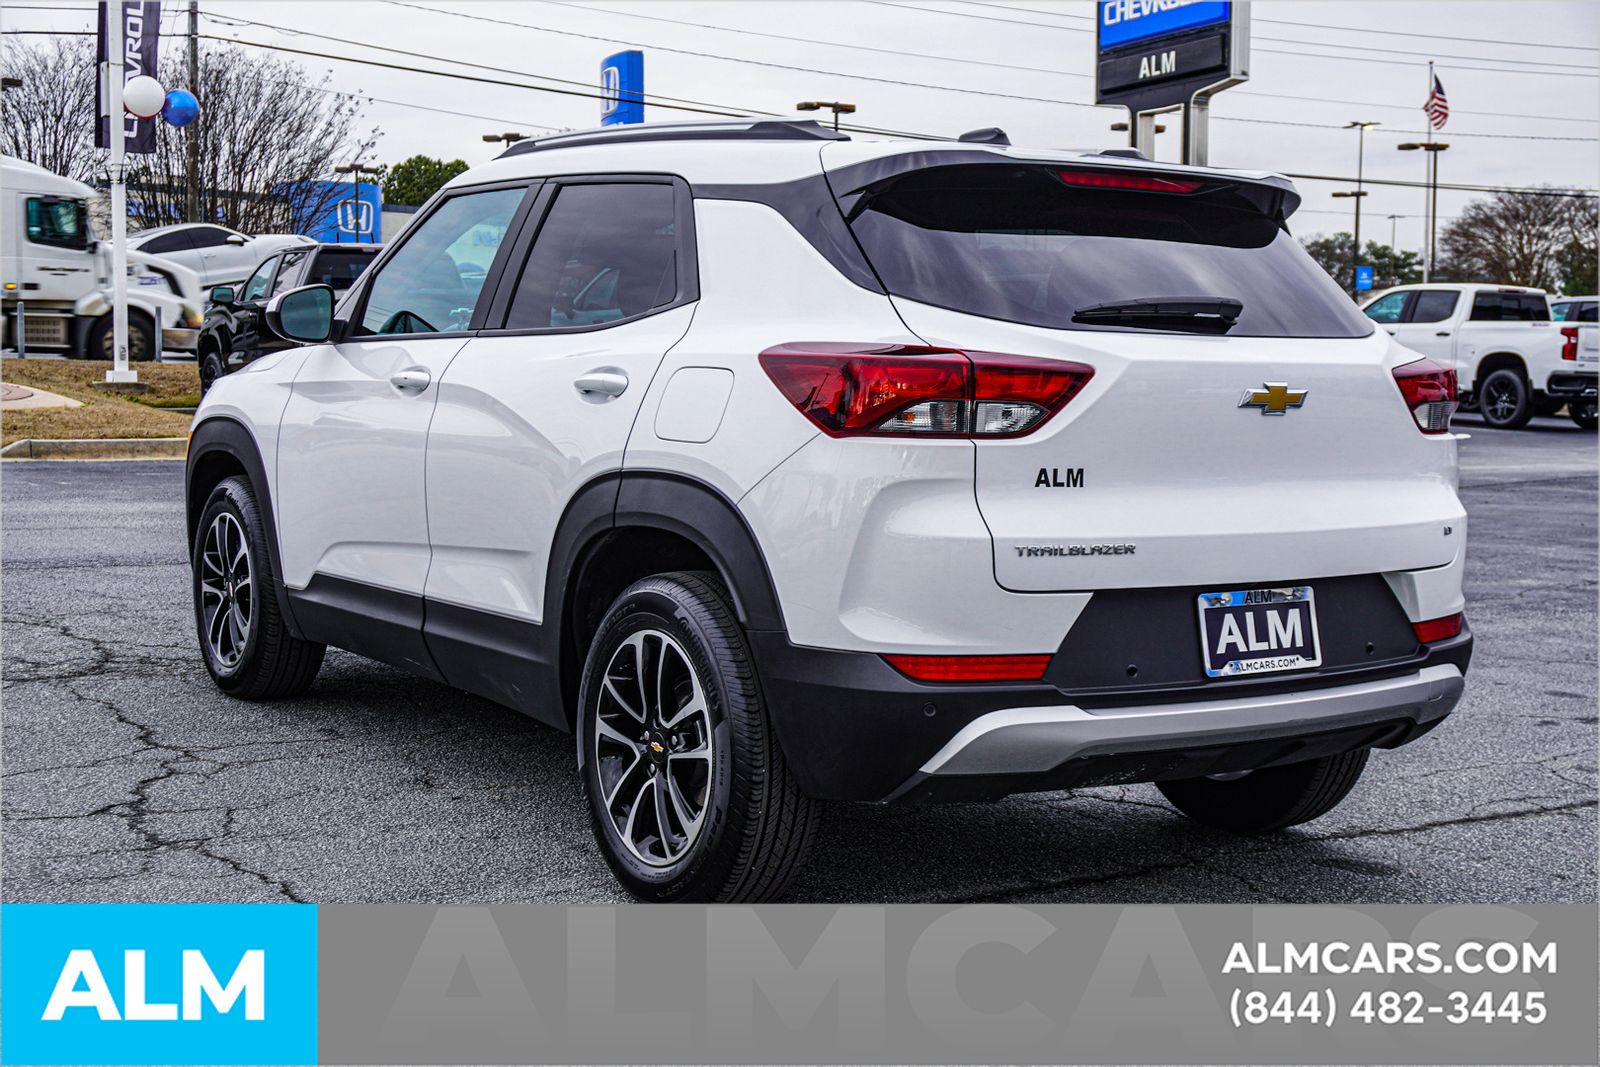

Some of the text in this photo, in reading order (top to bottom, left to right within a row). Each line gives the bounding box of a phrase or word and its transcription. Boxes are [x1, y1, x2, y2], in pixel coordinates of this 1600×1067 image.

[1139, 50, 1176, 79] ALM
[1034, 468, 1084, 488] ALM
[1014, 543, 1137, 558] TRAILBLAZER
[1244, 589, 1273, 605] ALM
[1216, 608, 1304, 655] ALM
[1234, 657, 1297, 672] ALMCARS.COM
